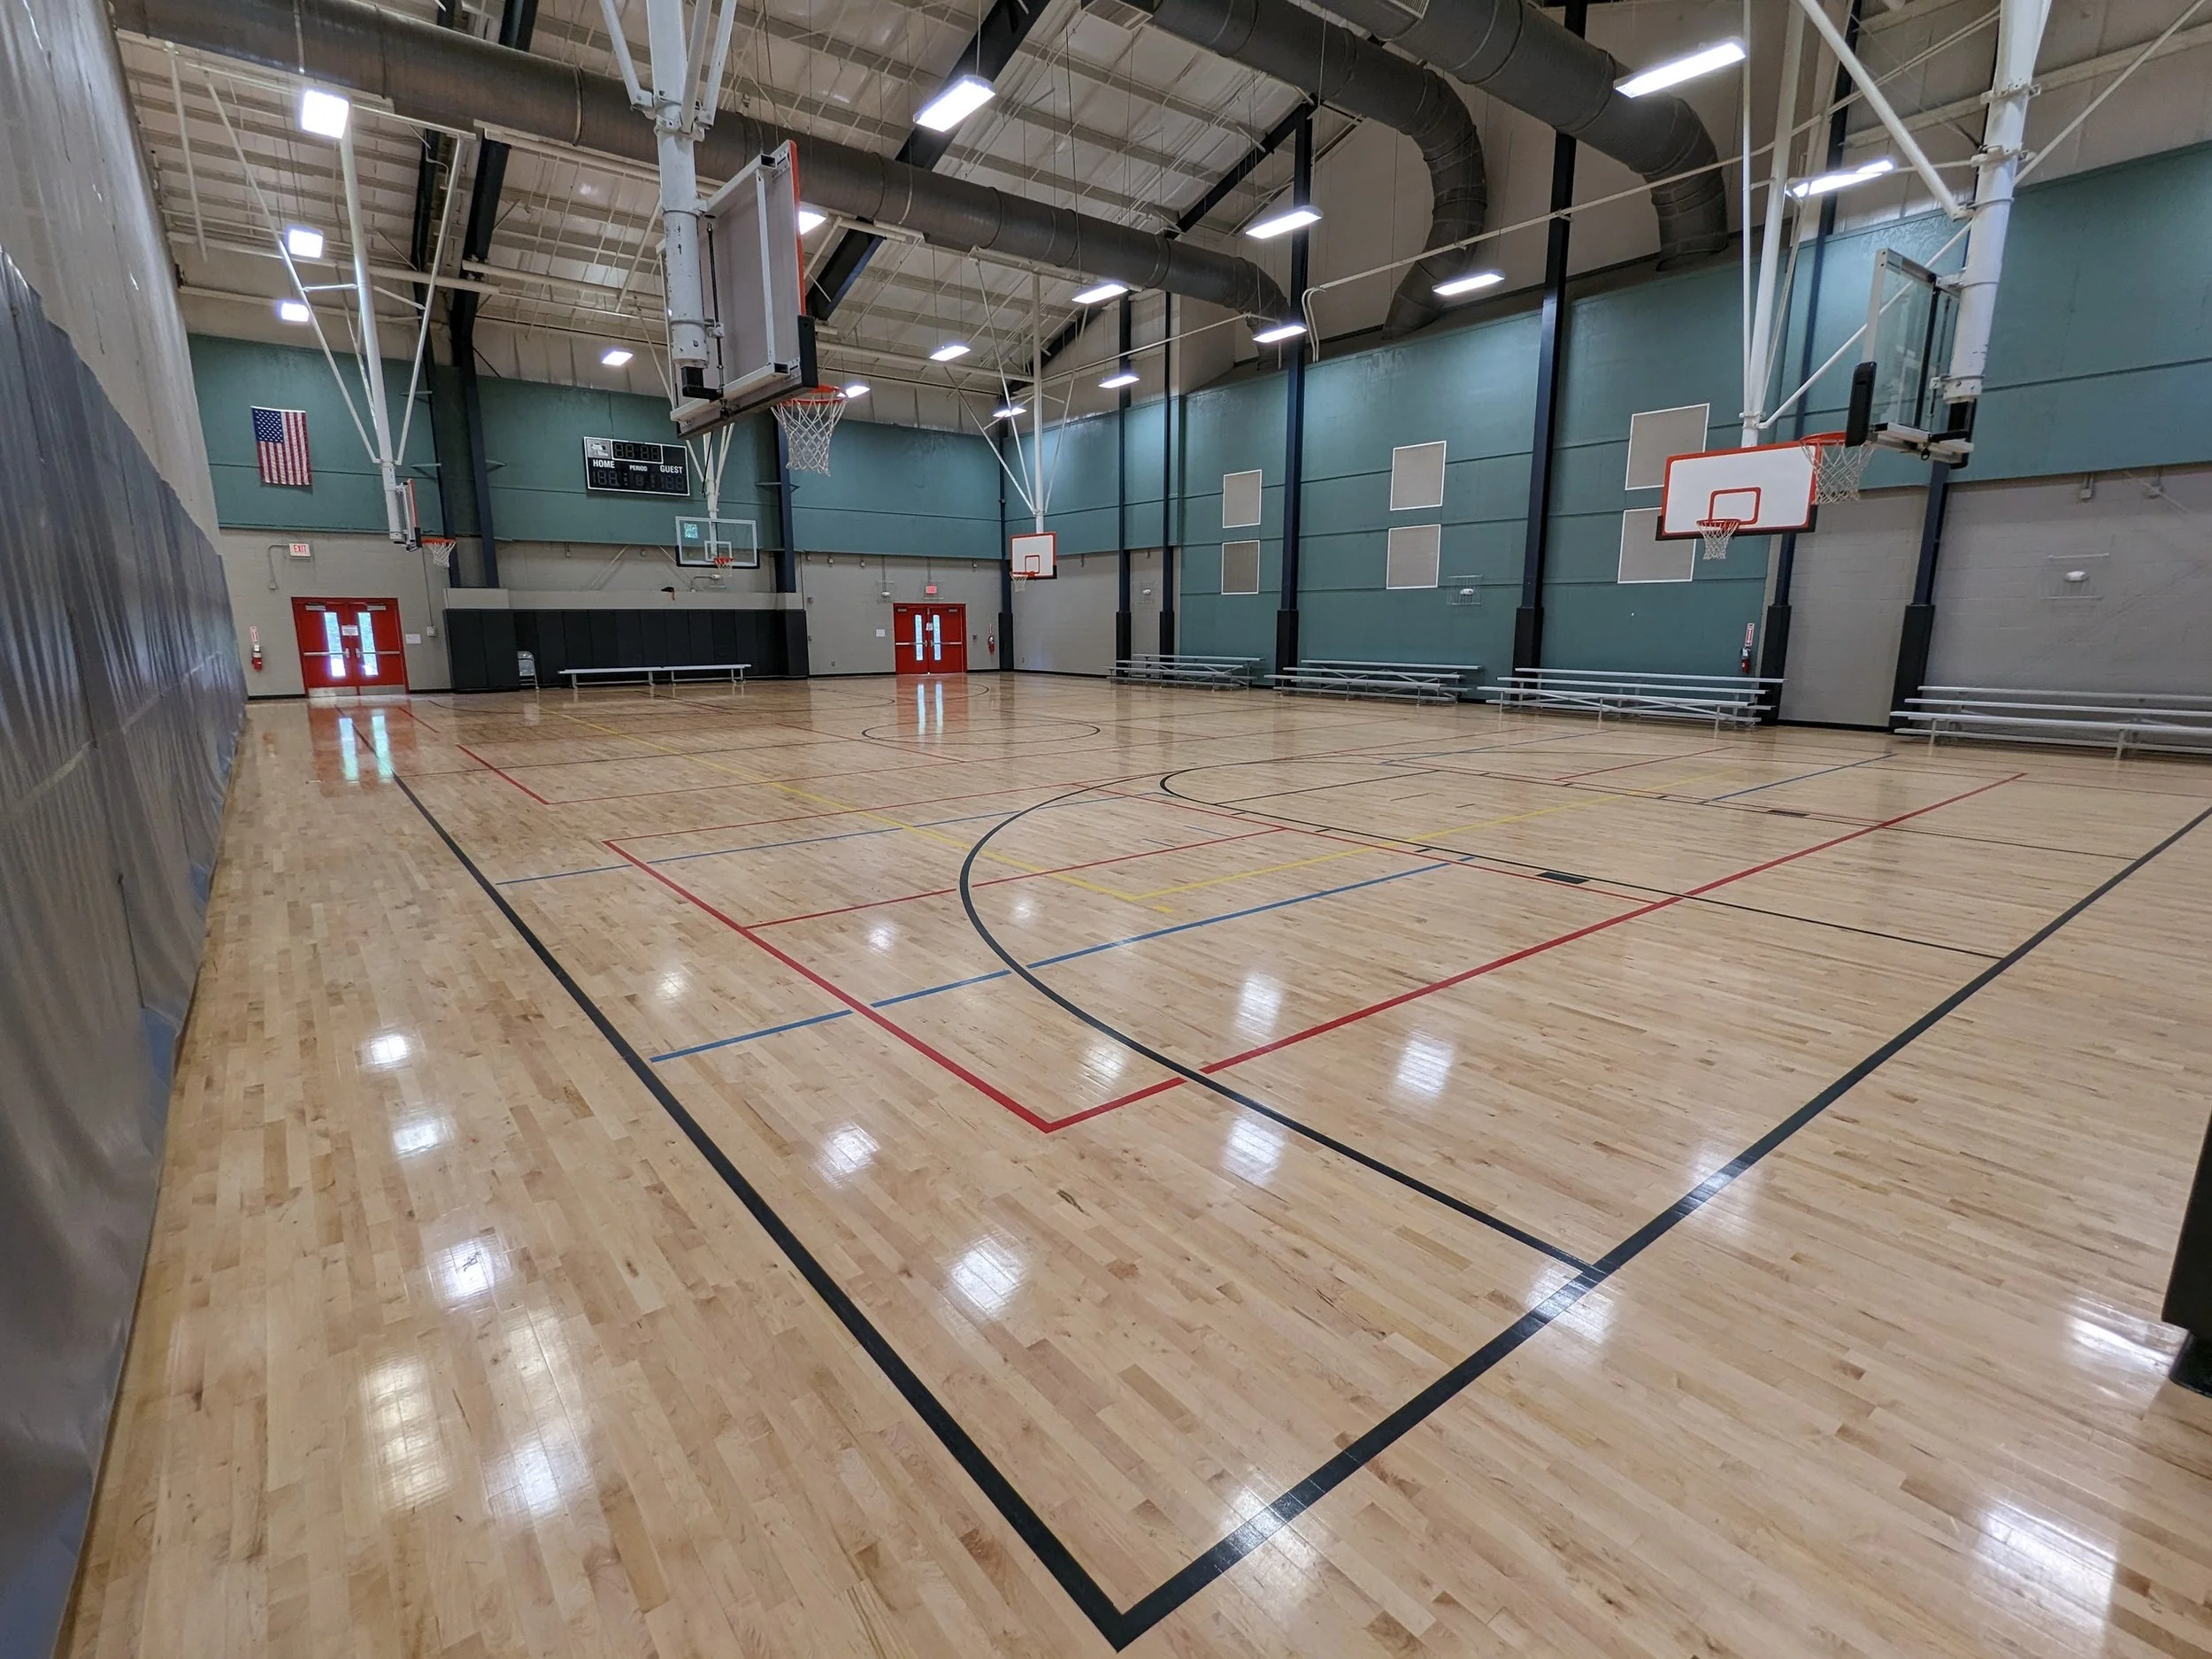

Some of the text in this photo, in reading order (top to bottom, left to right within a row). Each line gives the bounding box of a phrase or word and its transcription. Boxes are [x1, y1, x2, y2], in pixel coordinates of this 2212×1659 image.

[593, 459, 615, 468] HOME
[660, 465, 683, 473] GUEST
[293, 544, 307, 553] EXIT
